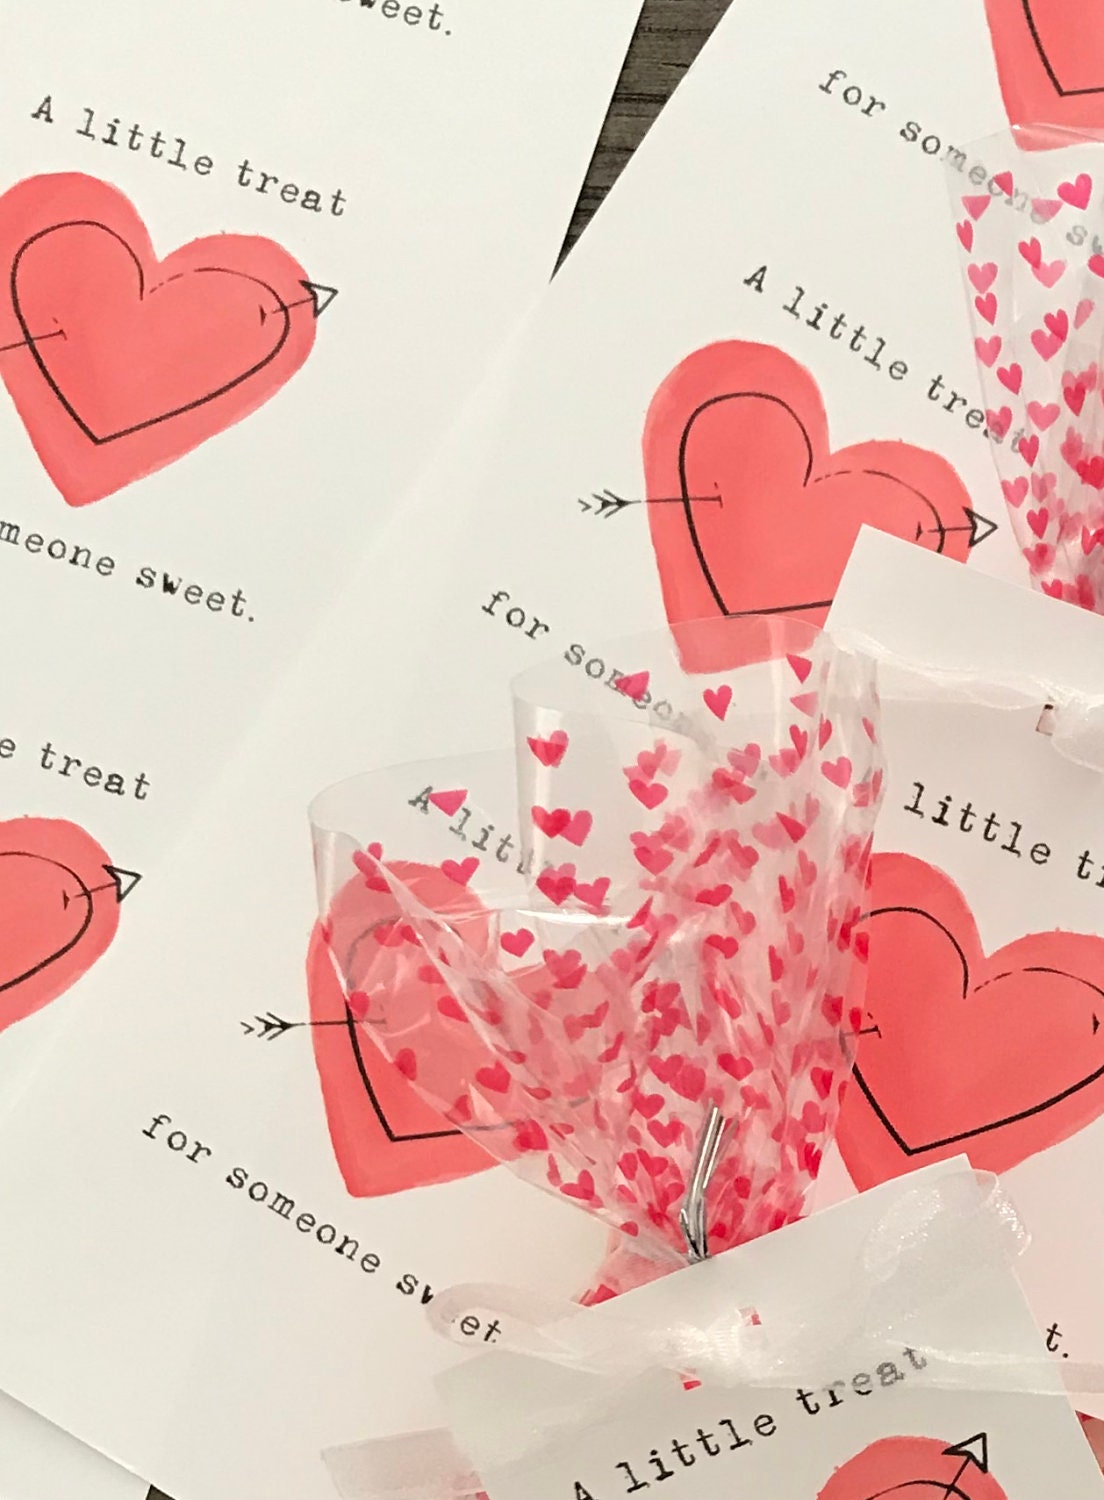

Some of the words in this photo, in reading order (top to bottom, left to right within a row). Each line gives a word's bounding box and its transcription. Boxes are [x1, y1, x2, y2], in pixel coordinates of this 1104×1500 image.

[339, 0, 452, 36] eet.
[818, 69, 886, 117] for
[30, 95, 54, 124] A
[75, 107, 214, 176] little
[237, 159, 347, 217] treat
[742, 265, 768, 294] A
[782, 285, 909, 381] little
[135, 567, 254, 623] sweet.
[481, 590, 550, 640] for
[564, 643, 694, 733] someo
[40, 742, 151, 801] treat
[408, 785, 433, 814] A
[449, 807, 534, 875] lit
[903, 781, 1051, 866] little
[141, 1114, 212, 1164] for
[225, 1167, 381, 1274] someone
[615, 1414, 777, 1494] little
[796, 1346, 928, 1415] treat
